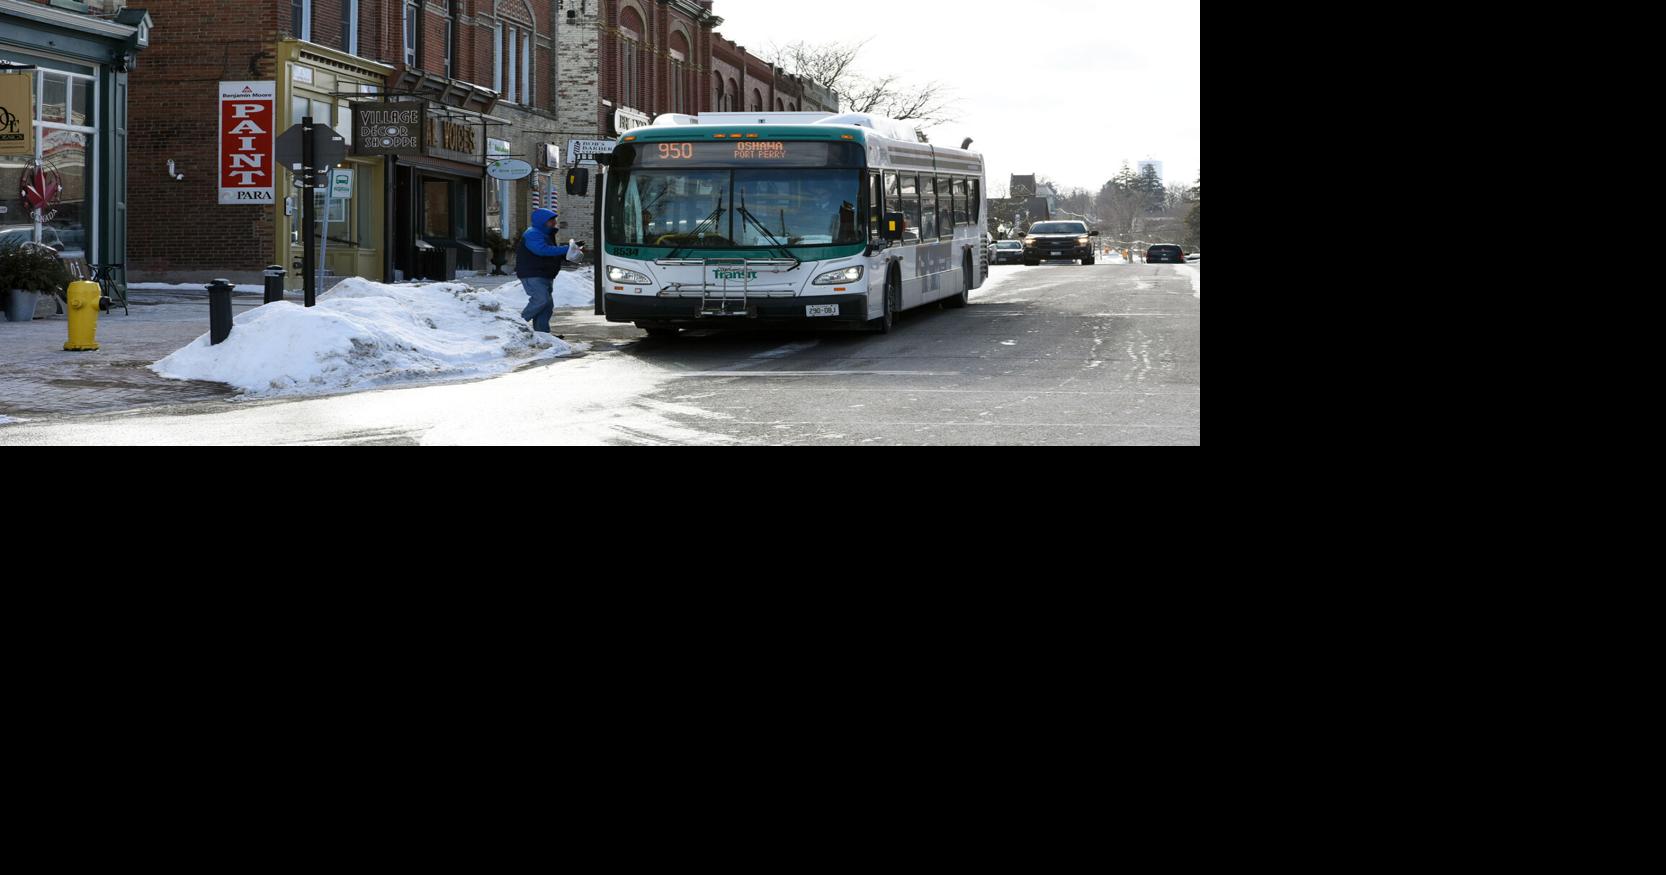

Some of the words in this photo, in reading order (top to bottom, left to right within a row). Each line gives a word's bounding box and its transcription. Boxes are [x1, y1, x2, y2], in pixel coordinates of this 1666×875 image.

[360, 110, 419, 125] VILLAGE
[228, 103, 267, 185] PAINT
[365, 137, 417, 148] SHOPPE
[737, 141, 784, 150] OSHAWA
[658, 142, 693, 159] 950
[734, 150, 754, 159] PORT
[758, 150, 786, 159] PERRY
[237, 191, 272, 200] PARA
[30, 208, 58, 223] CNADA
[712, 269, 758, 280] Transit
